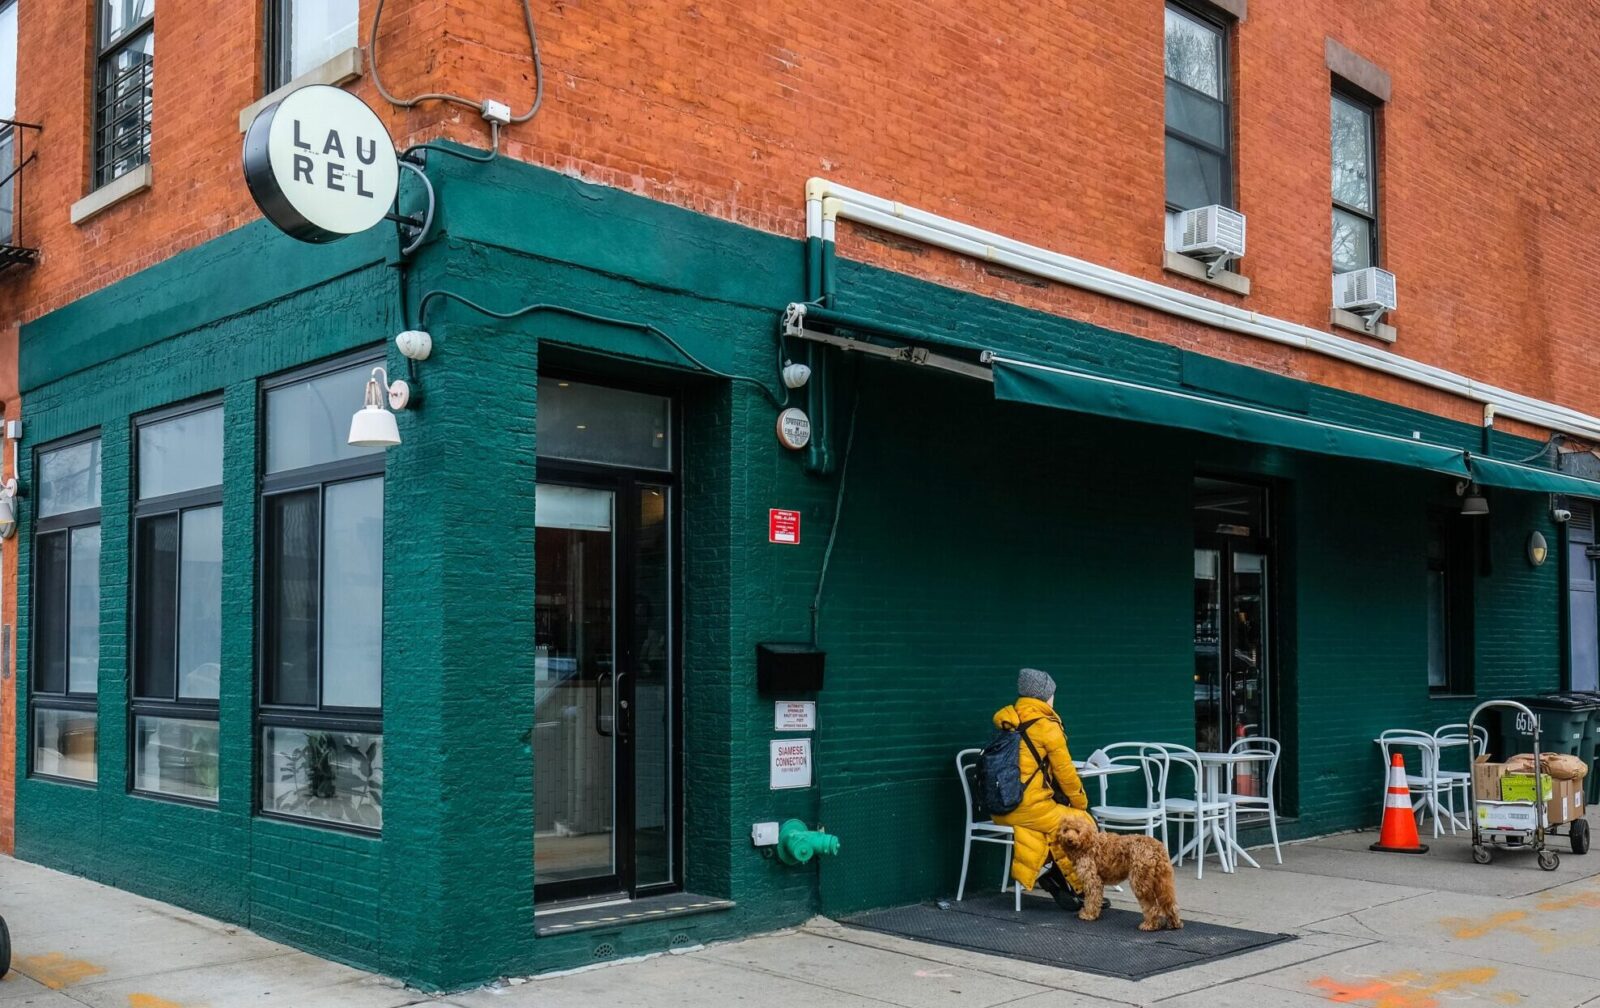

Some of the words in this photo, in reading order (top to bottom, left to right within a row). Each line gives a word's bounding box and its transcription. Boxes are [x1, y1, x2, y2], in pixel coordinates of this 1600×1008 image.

[293, 119, 376, 166] LAU
[293, 153, 375, 199] REL
[1516, 712, 1527, 731] 65
[1527, 713, 1544, 733] GL
[778, 745, 804, 756] SIAMESE
[775, 756, 807, 768] CONNECTION
